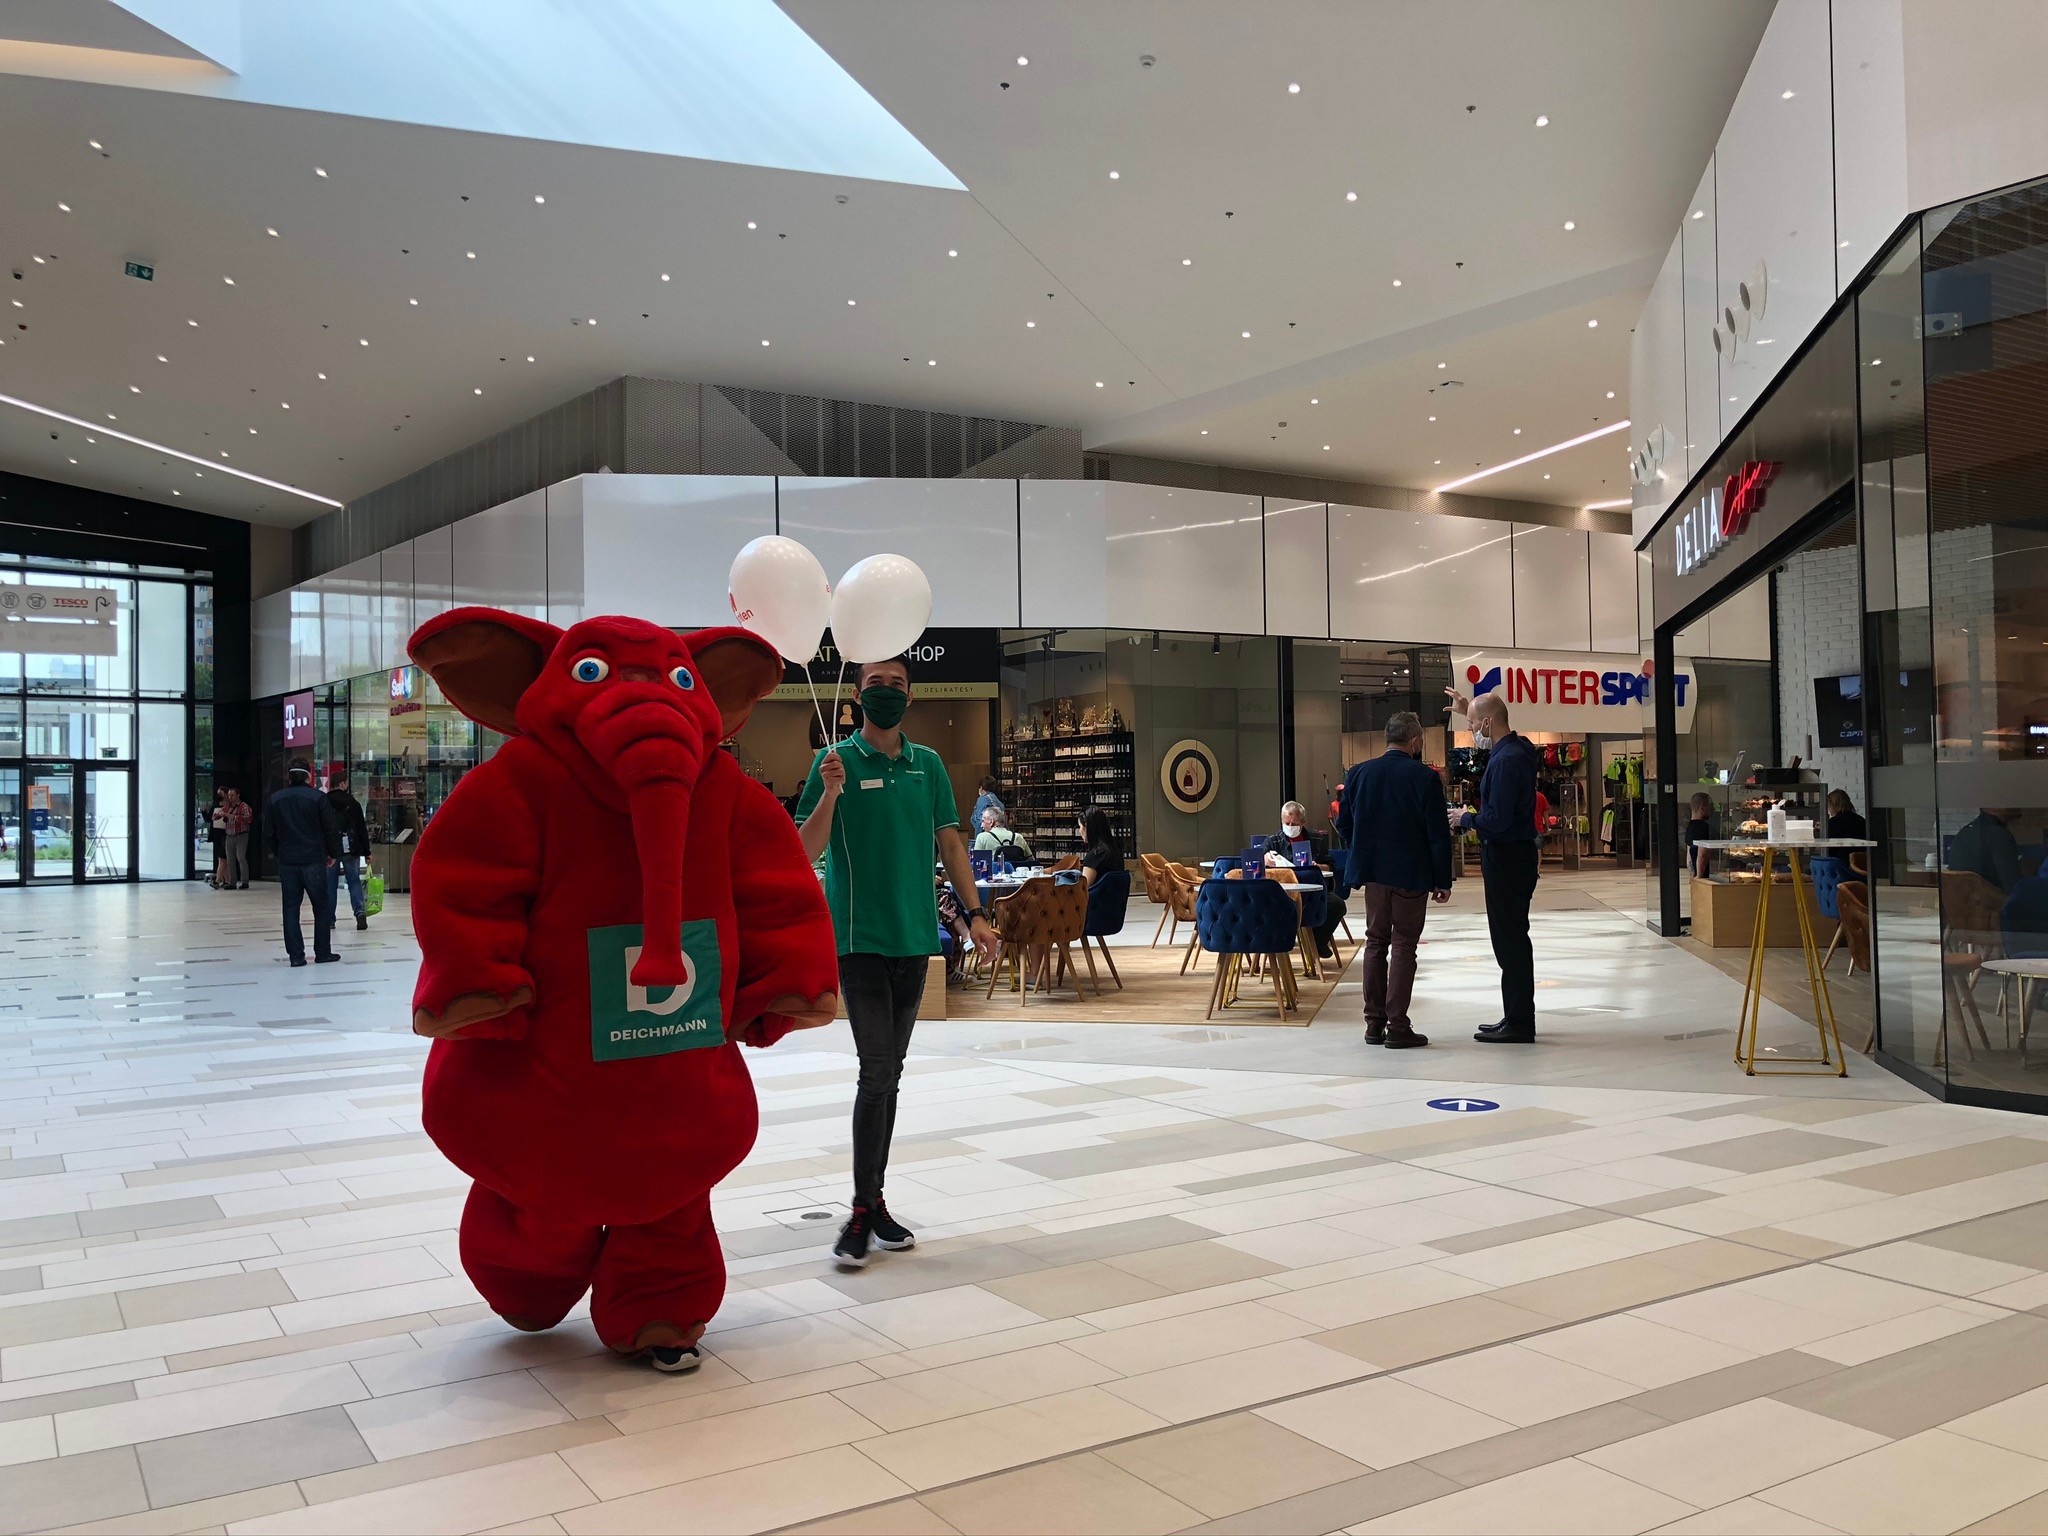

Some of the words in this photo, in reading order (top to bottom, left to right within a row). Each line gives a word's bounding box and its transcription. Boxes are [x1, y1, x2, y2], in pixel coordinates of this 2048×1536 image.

[1676, 487, 1722, 577] DELIA
[53, 597, 89, 606] TESCO
[904, 645, 945, 662] HOP
[1508, 666, 1690, 708] INTERSPOT
[610, 1018, 708, 1042] DEICHMANN
